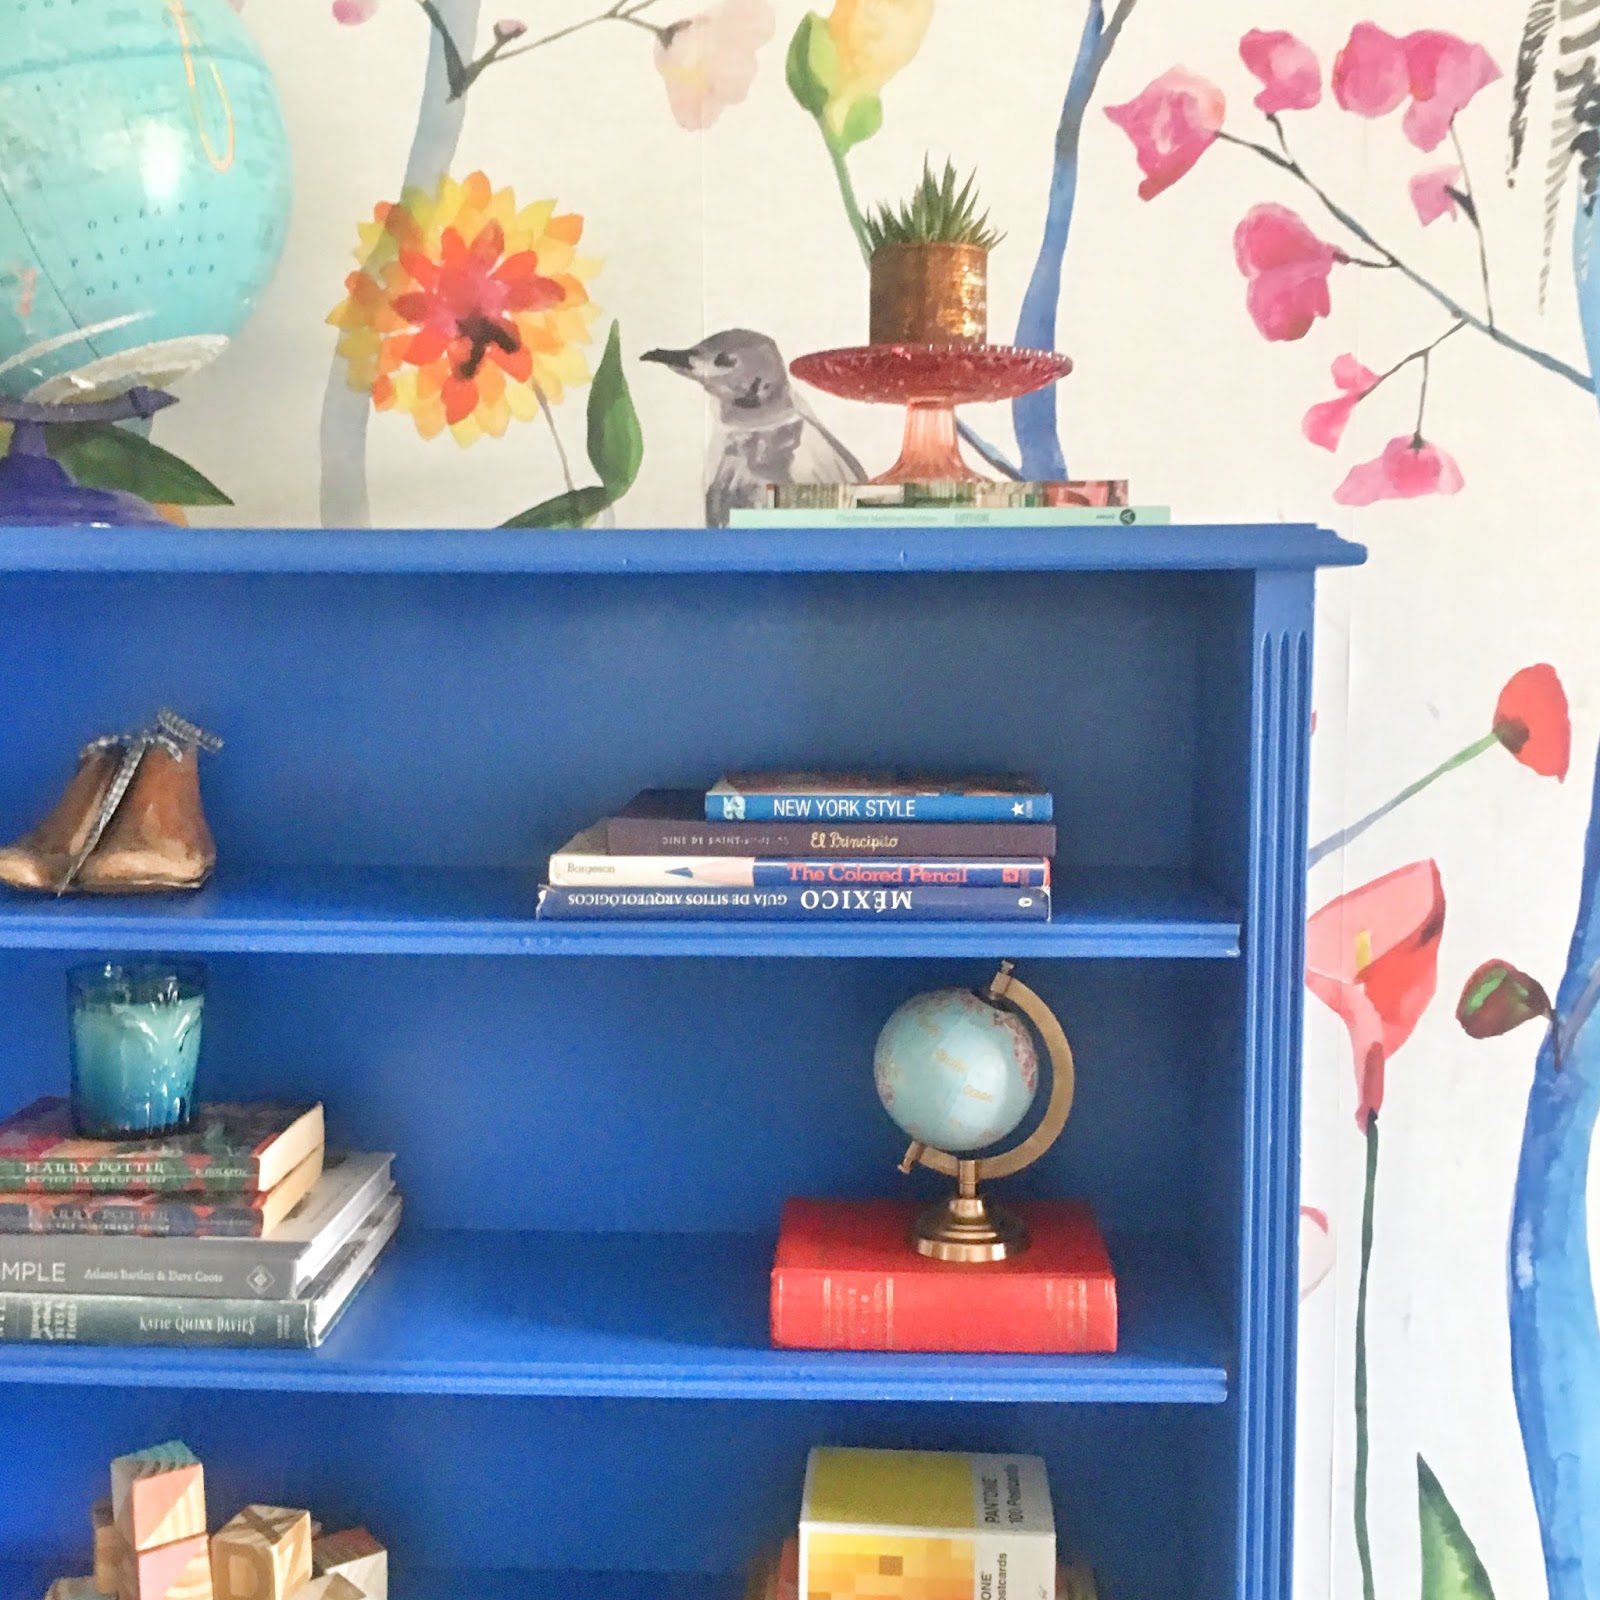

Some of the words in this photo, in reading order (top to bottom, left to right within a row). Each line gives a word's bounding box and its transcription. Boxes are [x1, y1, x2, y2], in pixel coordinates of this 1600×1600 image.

[773, 799, 812, 817] NEW
[816, 799, 860, 817] YORK
[865, 799, 916, 817] STYLE
[810, 832, 826, 848] El
[829, 832, 900, 851] Principito
[786, 862, 825, 882] The
[828, 863, 904, 884] Colored
[908, 864, 969, 884] Pencil
[686, 893, 728, 906] SITIOS
[731, 894, 750, 906] DE
[800, 890, 913, 913] MÉXICO
[24, 1161, 92, 1174] HARRY
[97, 1161, 166, 1174] POTTER
[168, 1269, 193, 1281] Dave
[982, 1476, 1000, 1523] PANTONE
